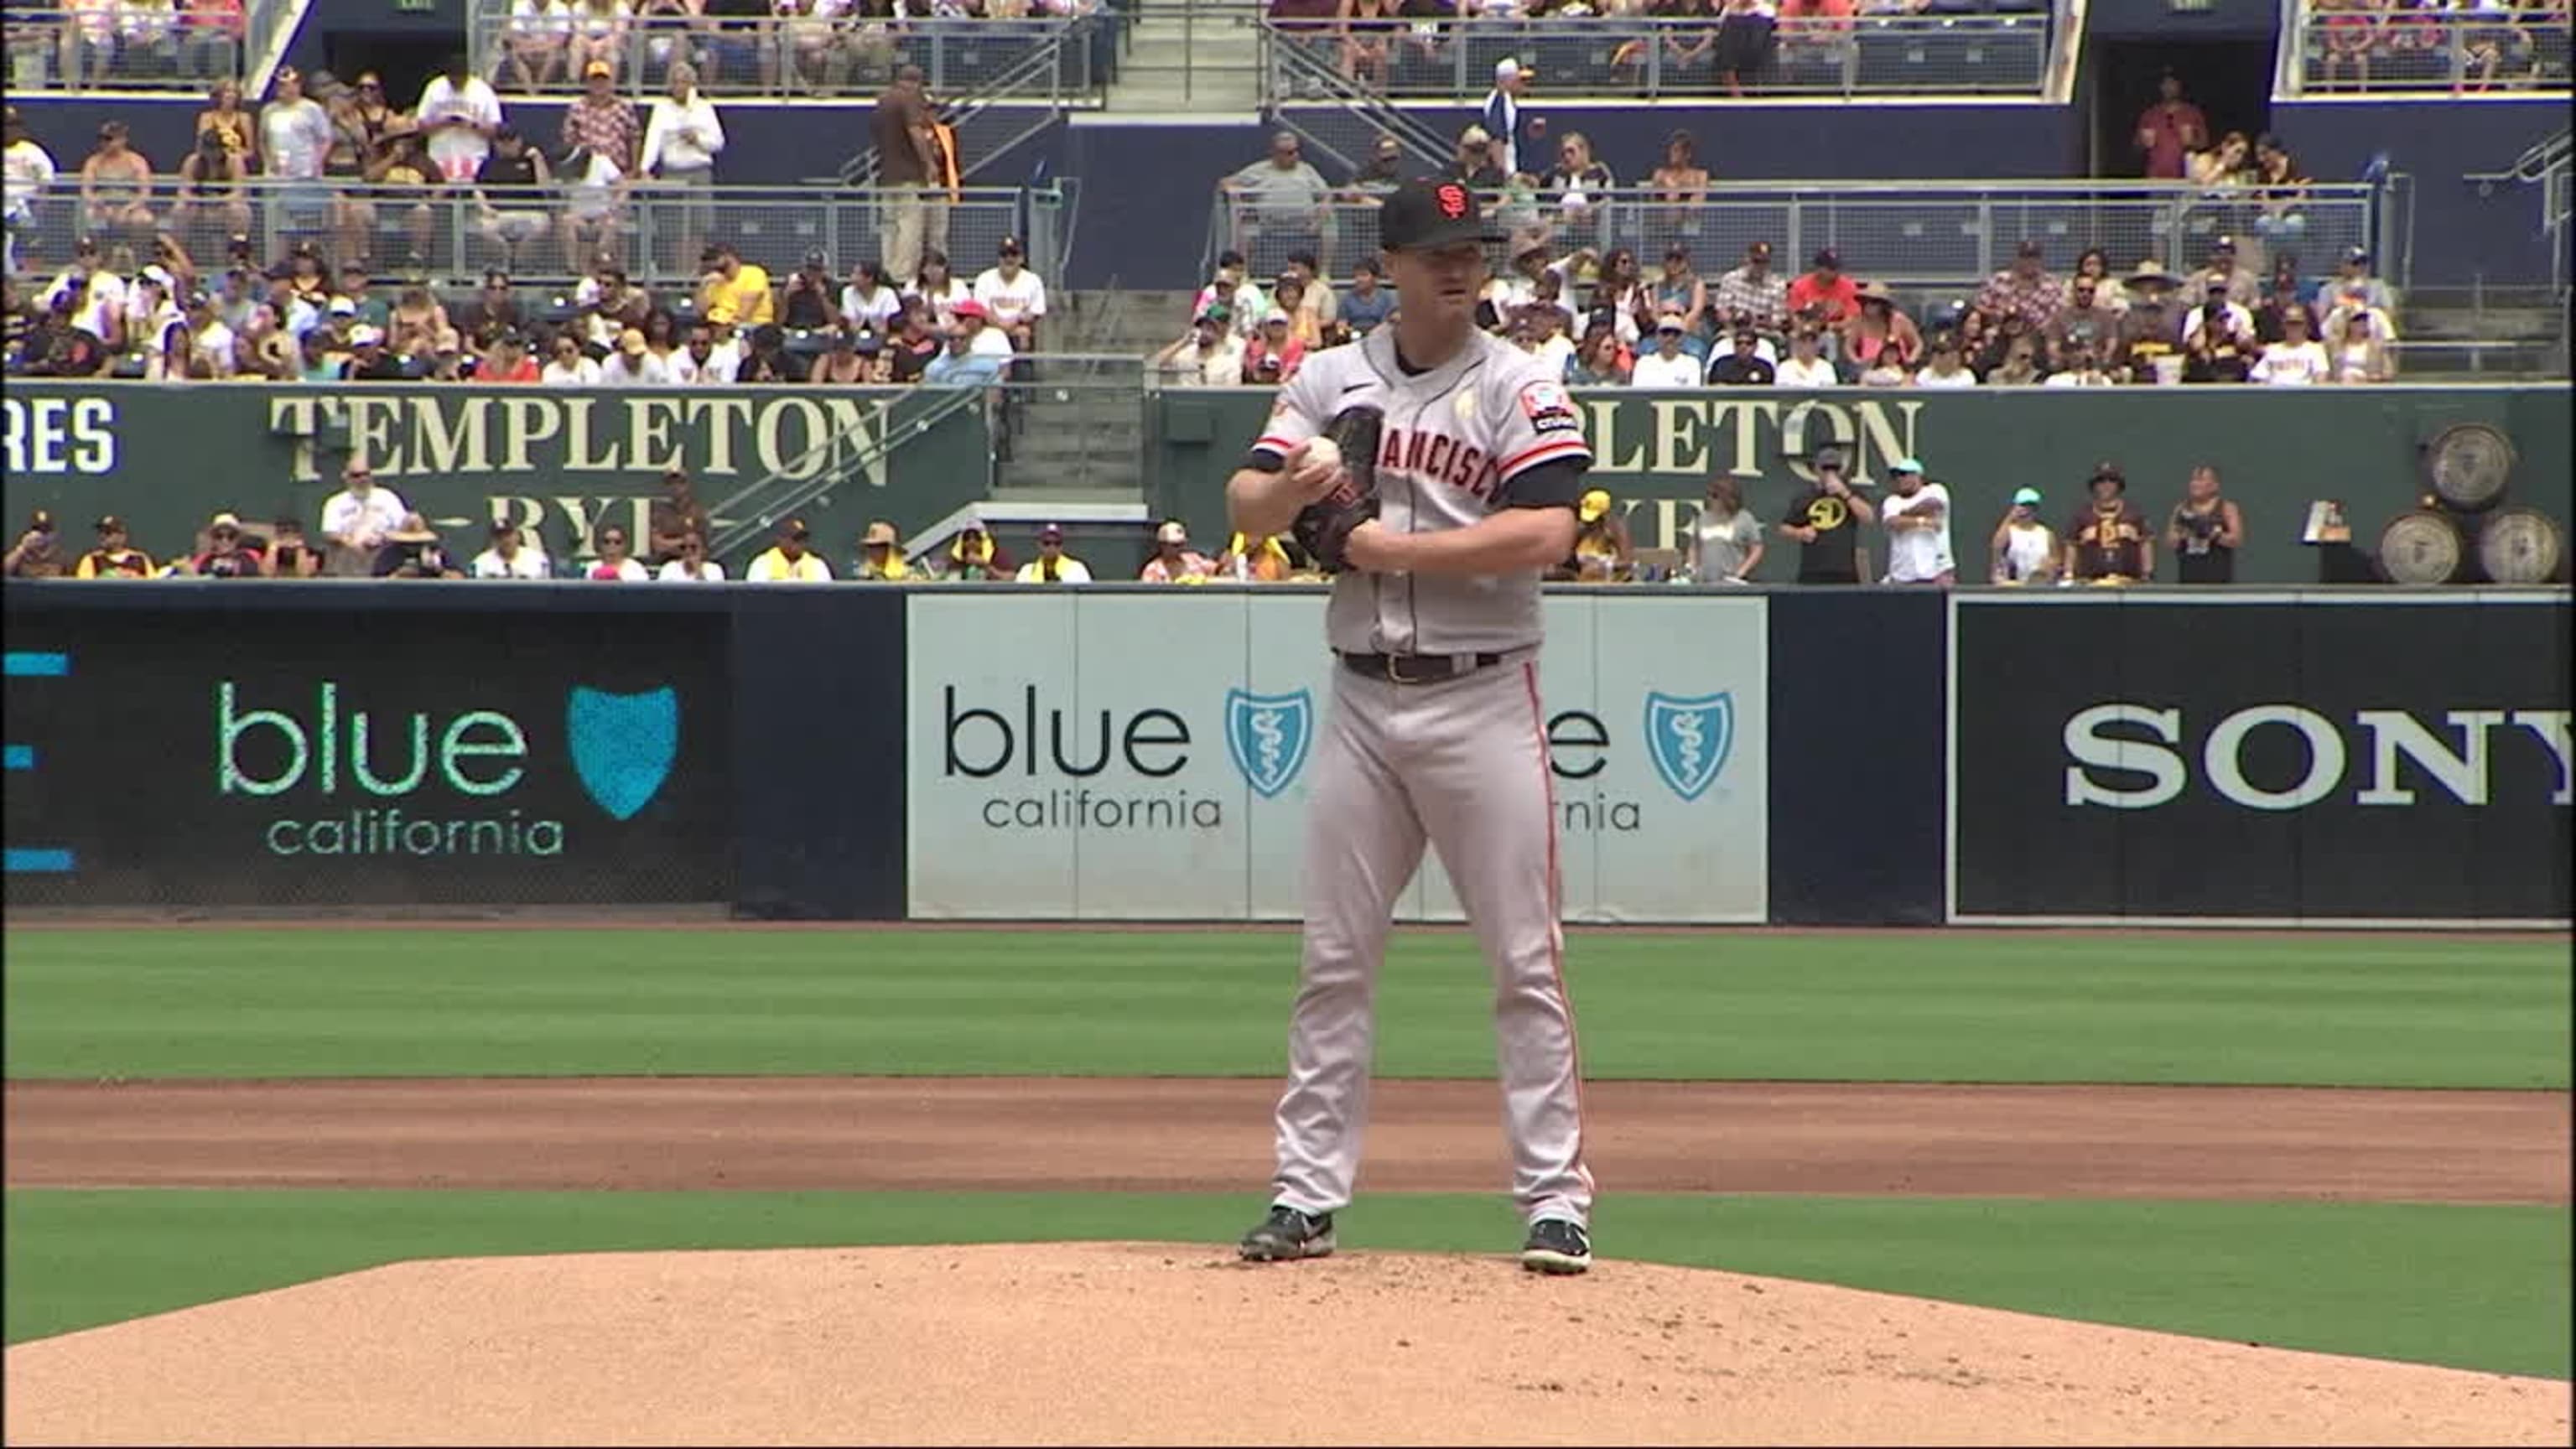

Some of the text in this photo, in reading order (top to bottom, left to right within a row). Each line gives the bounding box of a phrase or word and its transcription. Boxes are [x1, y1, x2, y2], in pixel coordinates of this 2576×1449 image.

[270, 396, 888, 486] TEMPLETON
[1377, 428, 1501, 505] ANCISC
[1575, 397, 1925, 486] LETON
[219, 682, 527, 795] blue
[944, 684, 1192, 778] blue
[267, 808, 564, 855] california
[982, 790, 1222, 829] california
